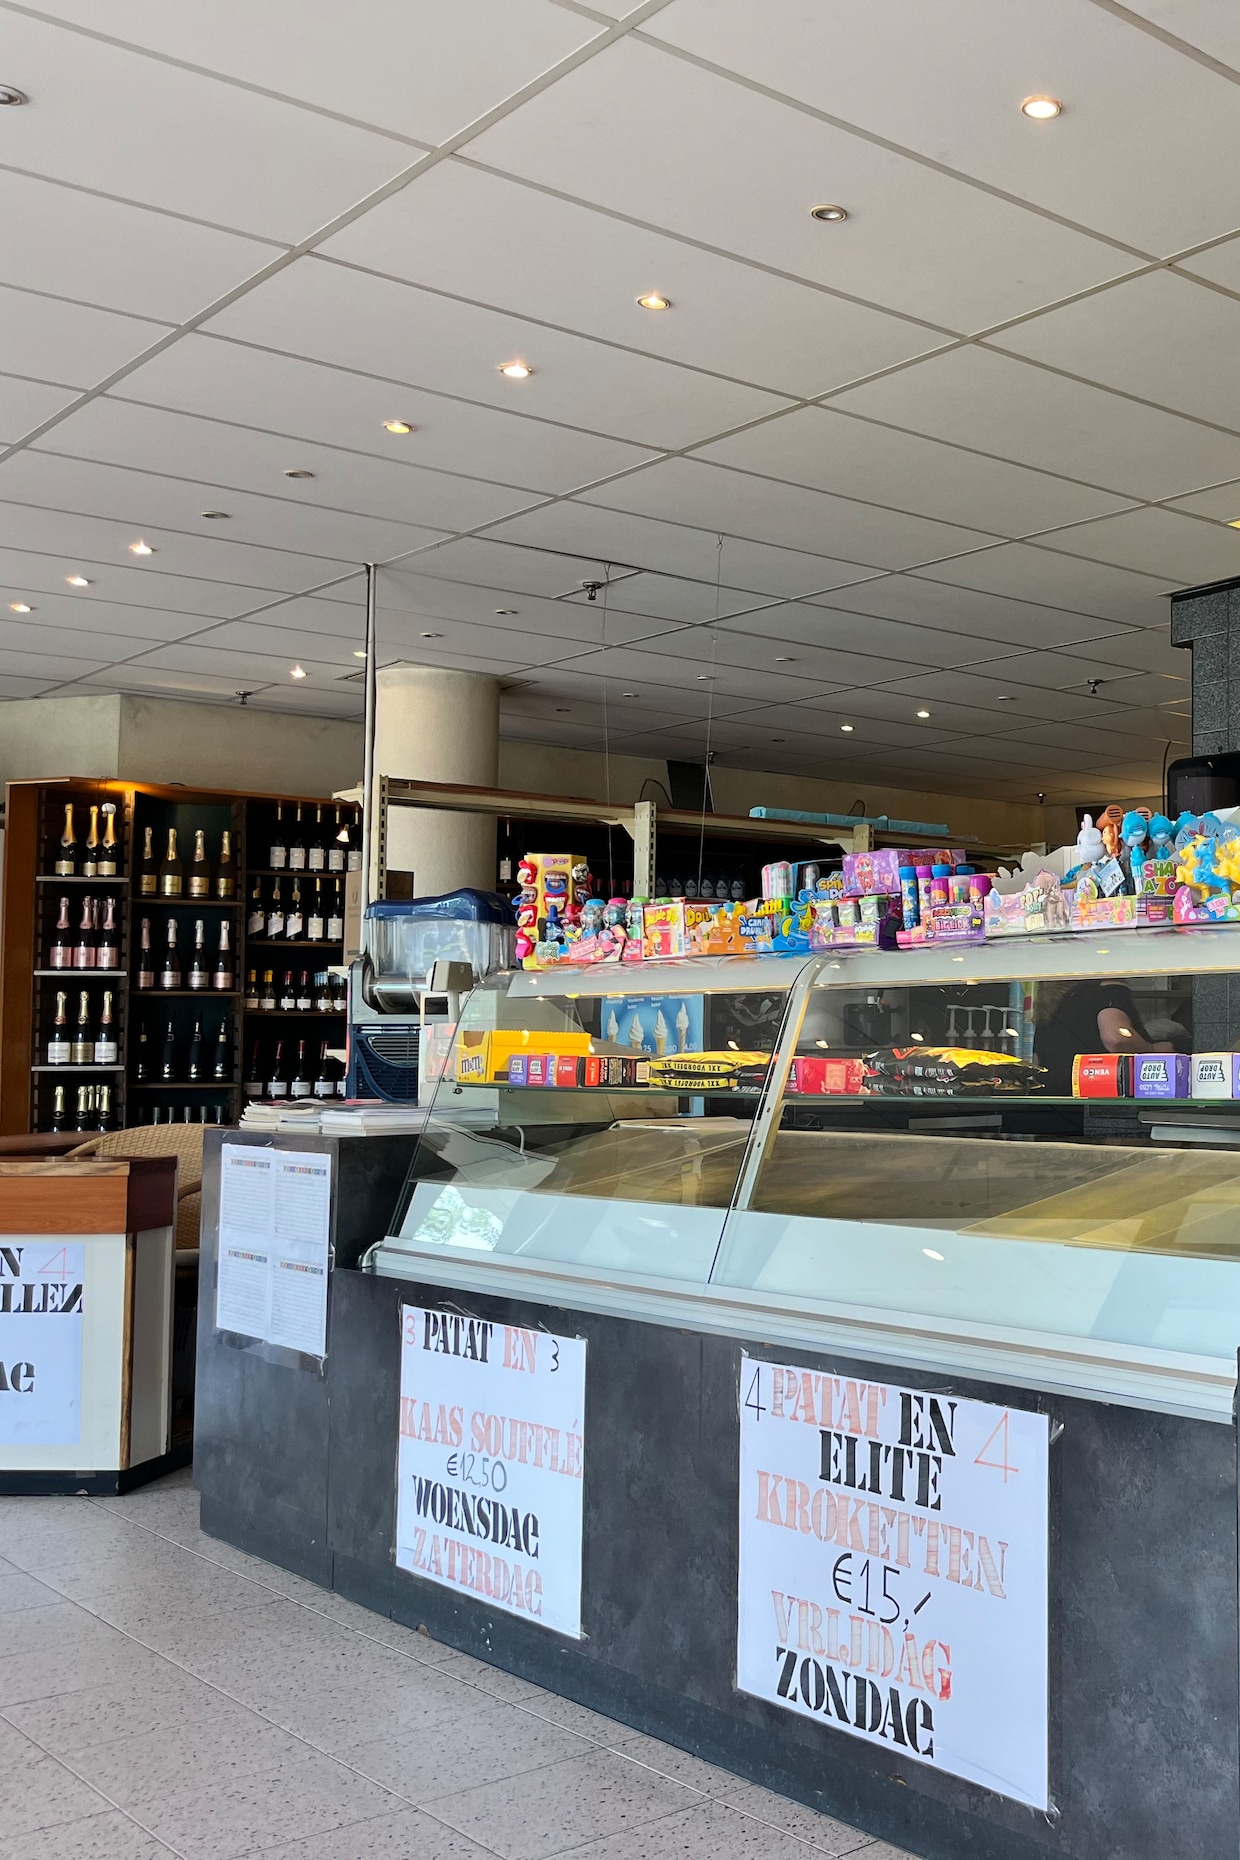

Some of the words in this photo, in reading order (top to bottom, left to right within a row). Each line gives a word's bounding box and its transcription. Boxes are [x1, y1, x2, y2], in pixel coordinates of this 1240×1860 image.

[1083, 1068, 1110, 1076] VENCO
[1143, 1064, 1162, 1072] DROP
[1199, 1064, 1218, 1072] DROP
[38, 1247, 74, 1281] 4
[405, 1315, 416, 1346] 3
[423, 1311, 493, 1363] PATAT
[503, 1326, 539, 1374] EN
[550, 1339, 560, 1372] 3
[400, 1396, 464, 1448] KAAS
[744, 1366, 766, 1422] 4
[771, 1367, 887, 1439] PATAT
[898, 1392, 958, 1457] EN
[973, 1411, 1019, 1484] 4
[819, 1430, 942, 1511] ELITE
[412, 1474, 540, 1559] WOENSDAG
[756, 1469, 1008, 1600] KROKETTEN
[413, 1527, 542, 1617] ZATERDAG
[771, 1590, 952, 1701] VRIJDAG
[776, 1646, 934, 1758] ZONDAG
